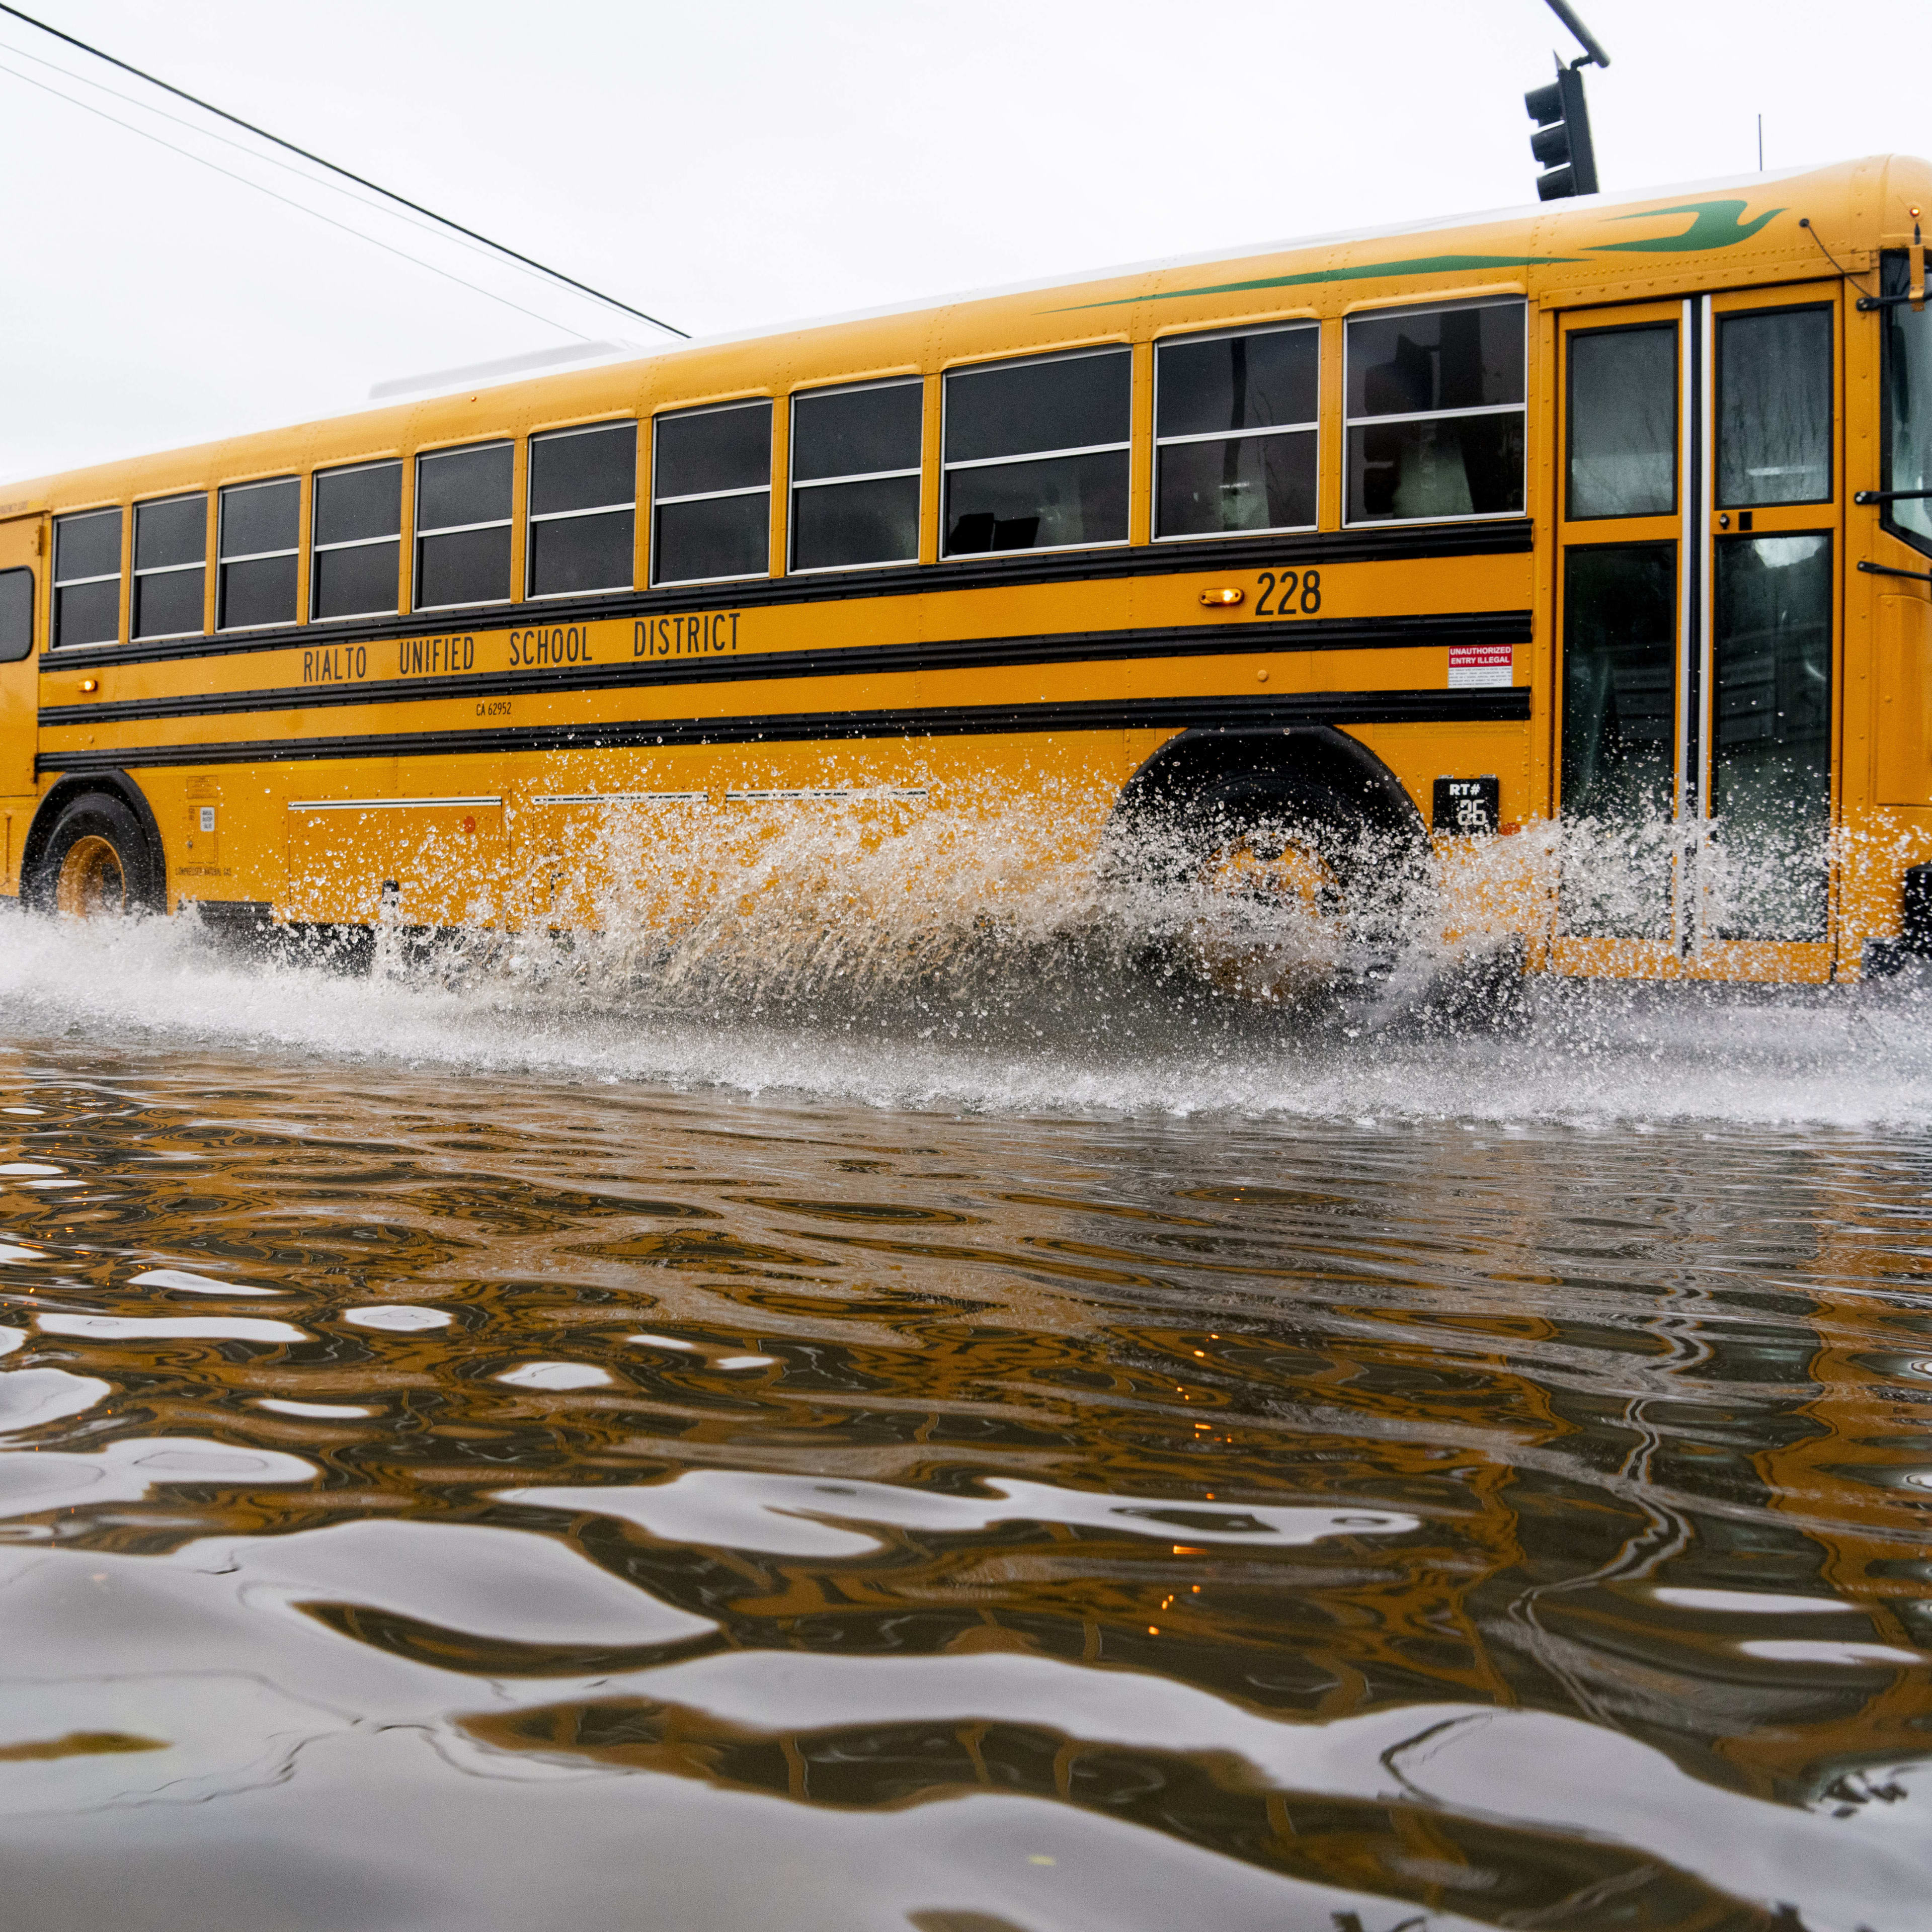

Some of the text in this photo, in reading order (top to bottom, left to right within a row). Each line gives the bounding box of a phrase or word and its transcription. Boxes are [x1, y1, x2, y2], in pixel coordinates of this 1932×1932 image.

[1255, 570, 1321, 616] 228
[303, 612, 741, 683] RIALTO UNIFIED SCHOOL DISTRICT
[1450, 647, 1511, 655] UNAUTHORIZED
[1451, 656, 1510, 665] ENTRY ILLEGAL
[476, 702, 512, 716] CA 62952
[1450, 784, 1481, 795] RT#
